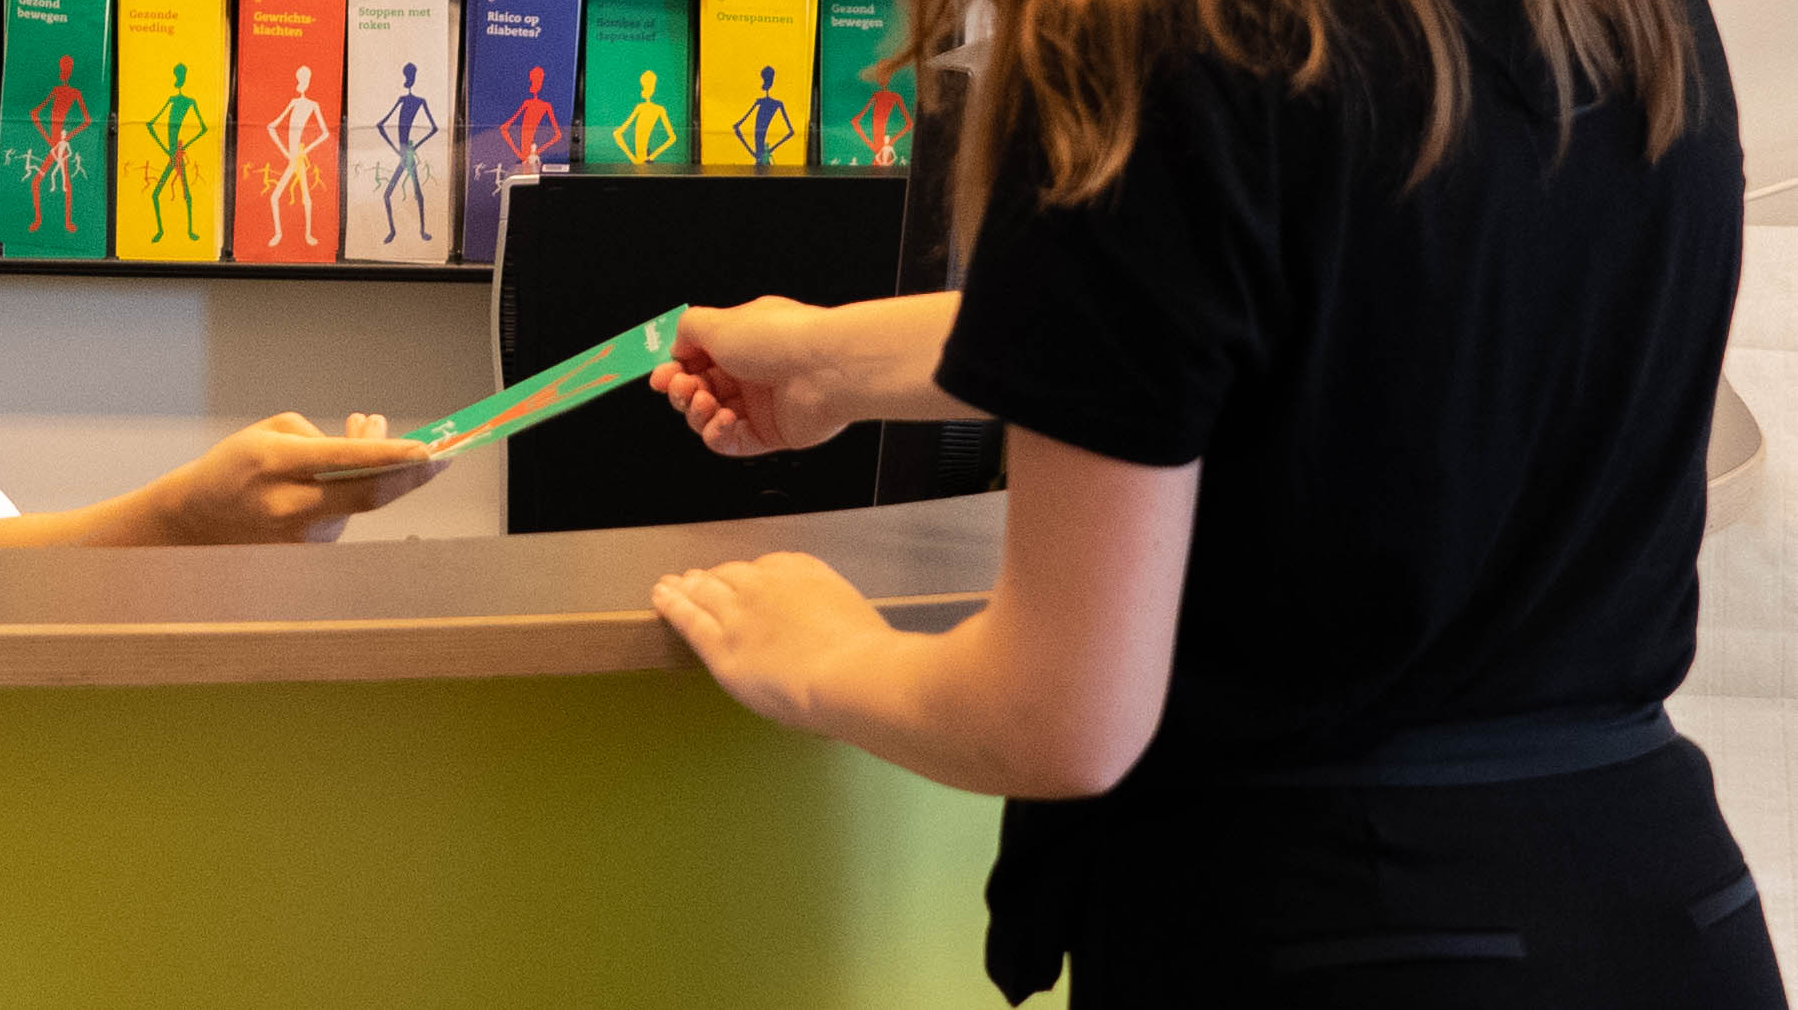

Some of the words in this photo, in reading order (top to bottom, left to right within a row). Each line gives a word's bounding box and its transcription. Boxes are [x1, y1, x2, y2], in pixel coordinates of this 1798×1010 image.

[17, 7, 68, 24] bewegen
[129, 9, 179, 21] Gezonde
[358, 6, 405, 19] Stoppen
[408, 7, 431, 18] met
[831, 4, 875, 16] Gezond
[253, 11, 316, 25] Gewrichts-
[486, 11, 522, 24] Risico
[524, 14, 540, 27] op
[716, 11, 794, 25] Overspannen
[831, 16, 884, 31] bewegen
[129, 22, 175, 35] voeding
[253, 24, 303, 37] klachten
[358, 21, 391, 31] roken
[486, 24, 542, 38] diabetes?
